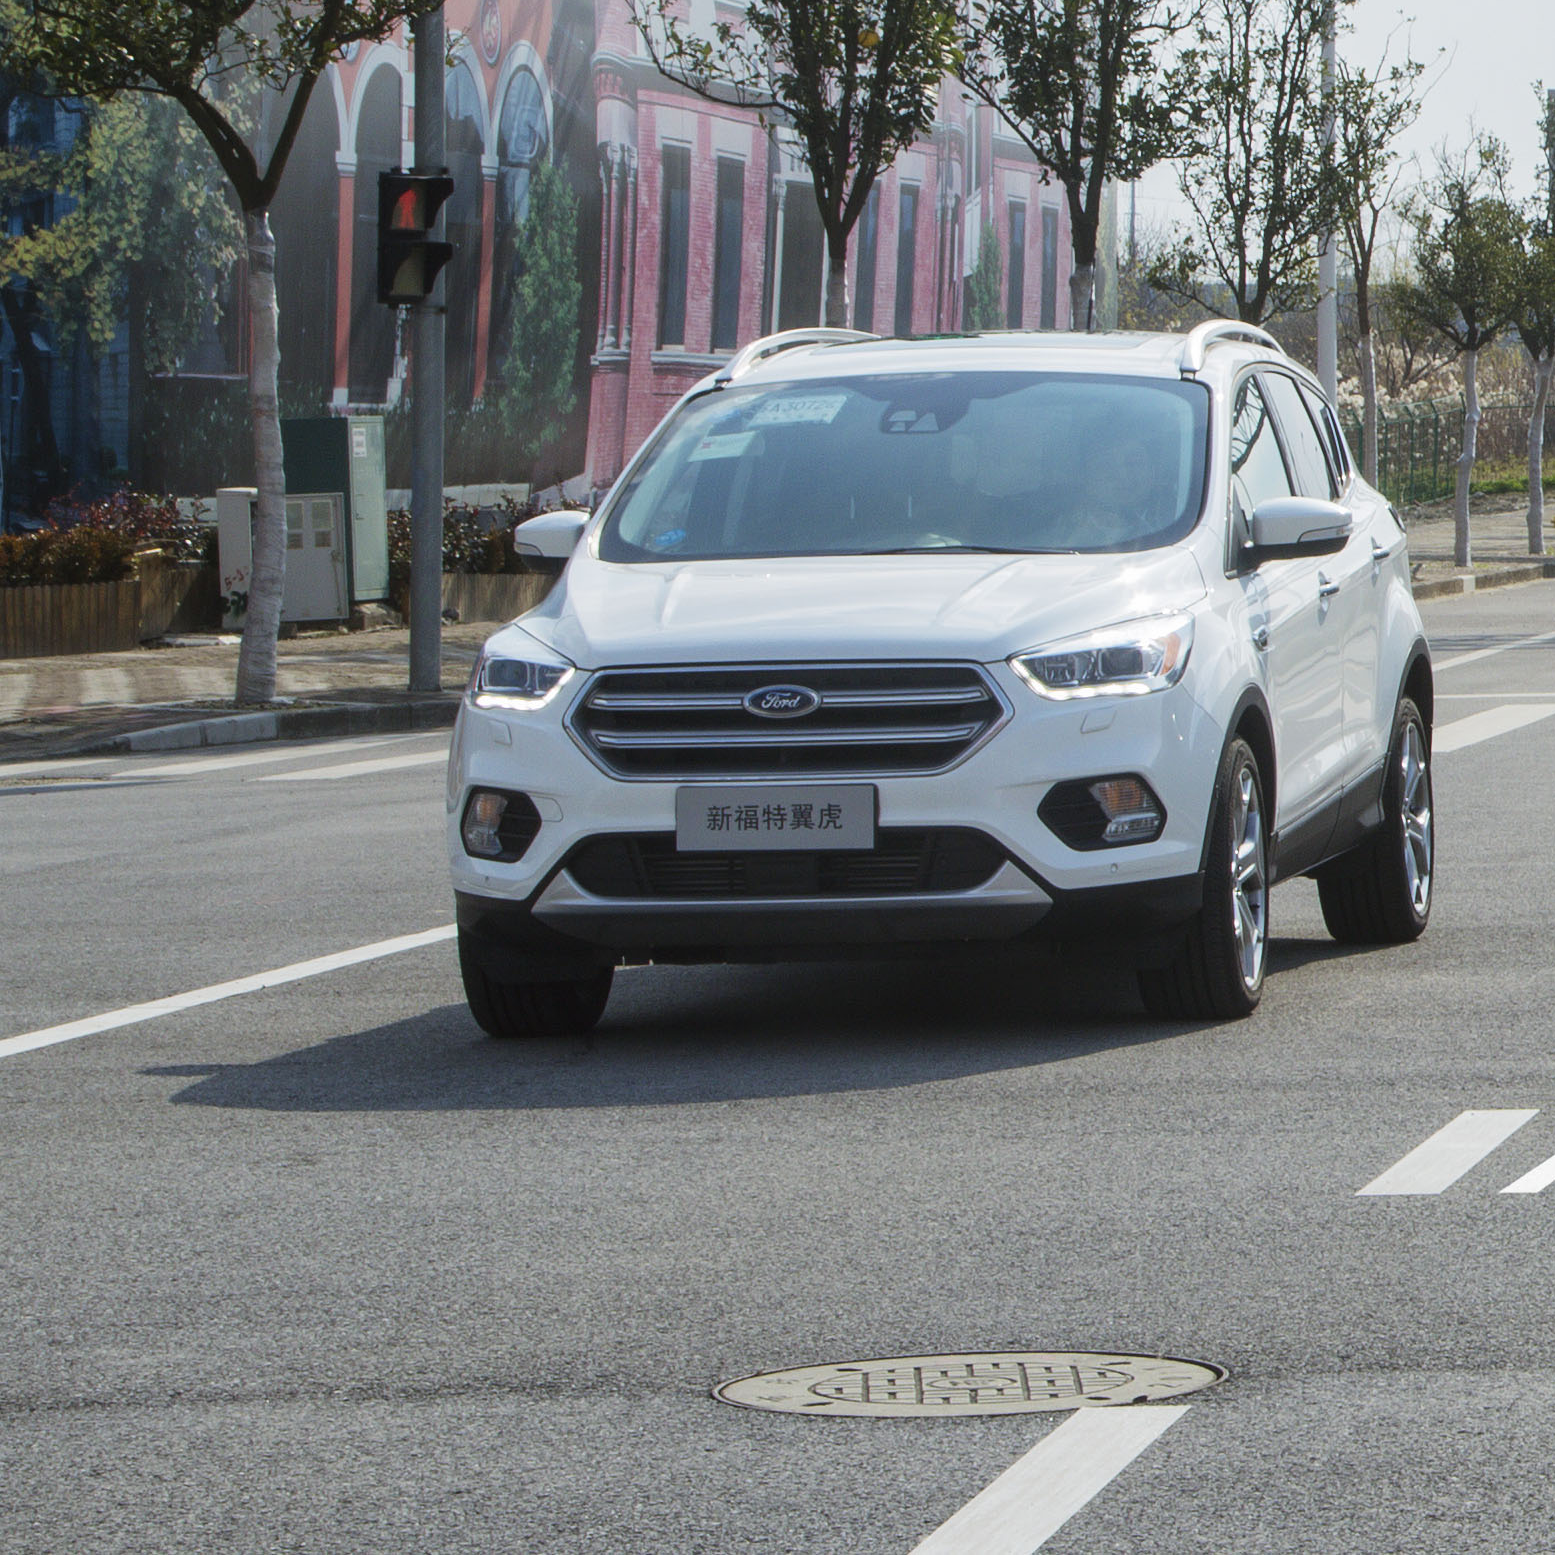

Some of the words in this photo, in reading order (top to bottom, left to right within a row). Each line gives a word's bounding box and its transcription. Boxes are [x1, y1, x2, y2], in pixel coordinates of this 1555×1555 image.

[760, 692, 801, 709] Ford
[706, 803, 843, 832] 新福特翼虎
